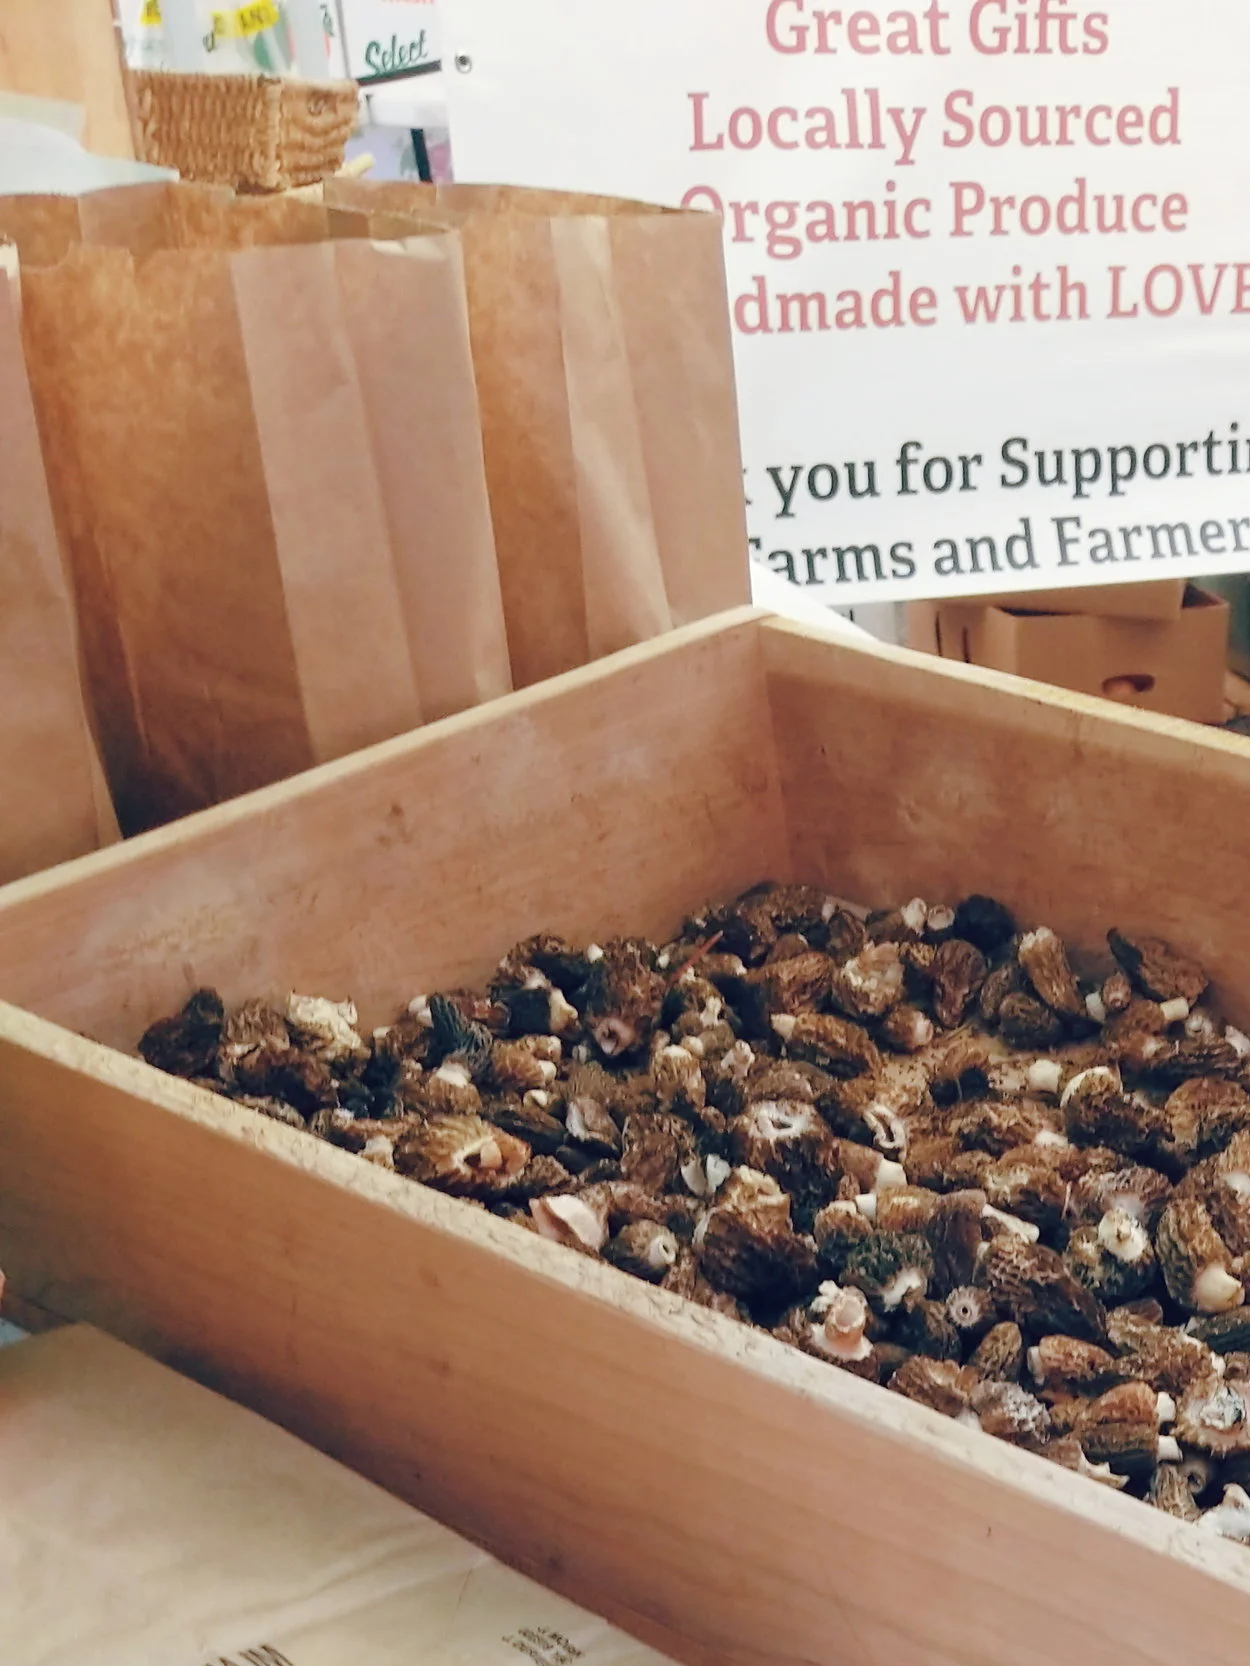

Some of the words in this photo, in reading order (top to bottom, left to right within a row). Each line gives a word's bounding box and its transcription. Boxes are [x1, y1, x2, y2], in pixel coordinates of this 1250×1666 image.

[365, 29, 428, 76] Select
[766, 0, 951, 55] Great
[969, 0, 1108, 55] Gifts
[688, 88, 926, 166] Locally
[943, 87, 1181, 148] Sourced
[949, 177, 1188, 237] Produce
[734, 270, 937, 335] dmade
[954, 265, 1090, 324] with
[766, 461, 880, 518] you
[896, 441, 982, 495] for
[748, 538, 916, 585] arms
[934, 518, 1039, 576] and
